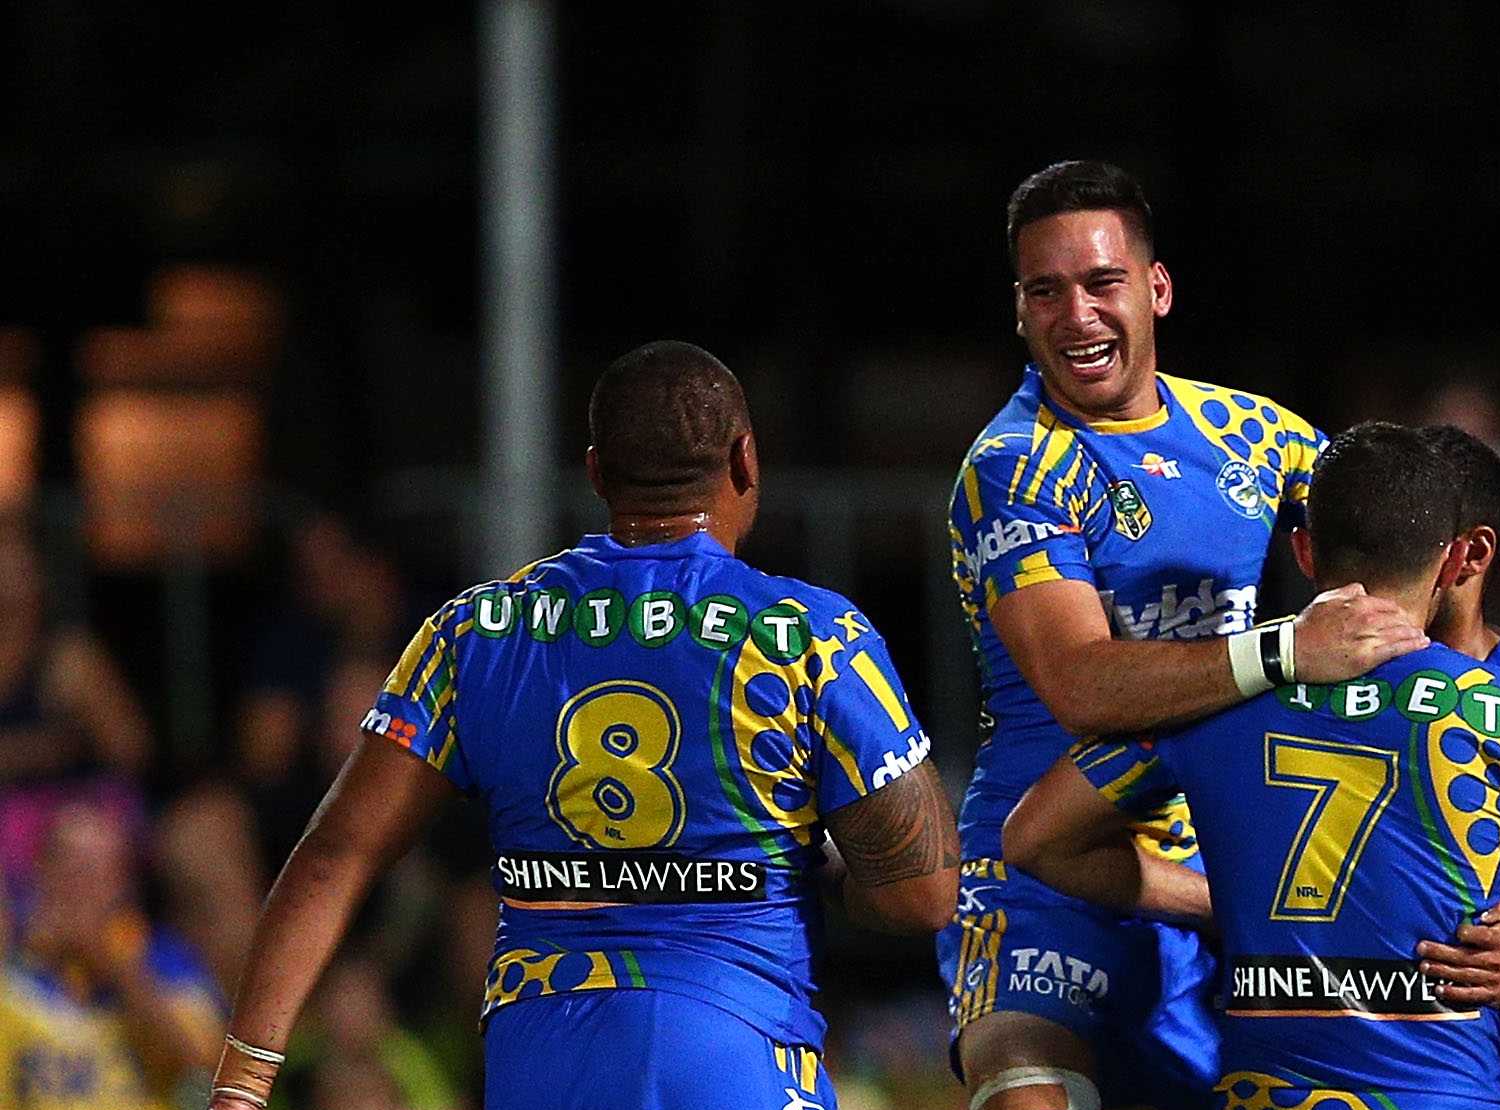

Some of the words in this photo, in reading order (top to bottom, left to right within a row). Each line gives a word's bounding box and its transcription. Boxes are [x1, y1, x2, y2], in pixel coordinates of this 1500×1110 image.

[476, 594, 801, 653] UNIBET
[545, 679, 687, 850] 8
[1264, 731, 1400, 922] 7
[498, 855, 591, 890] SHINE
[600, 860, 758, 893] LAWYERS
[1296, 886, 1324, 898] NRL
[1232, 966, 1314, 998] SHINE
[1321, 968, 1450, 1002] LAWYE
